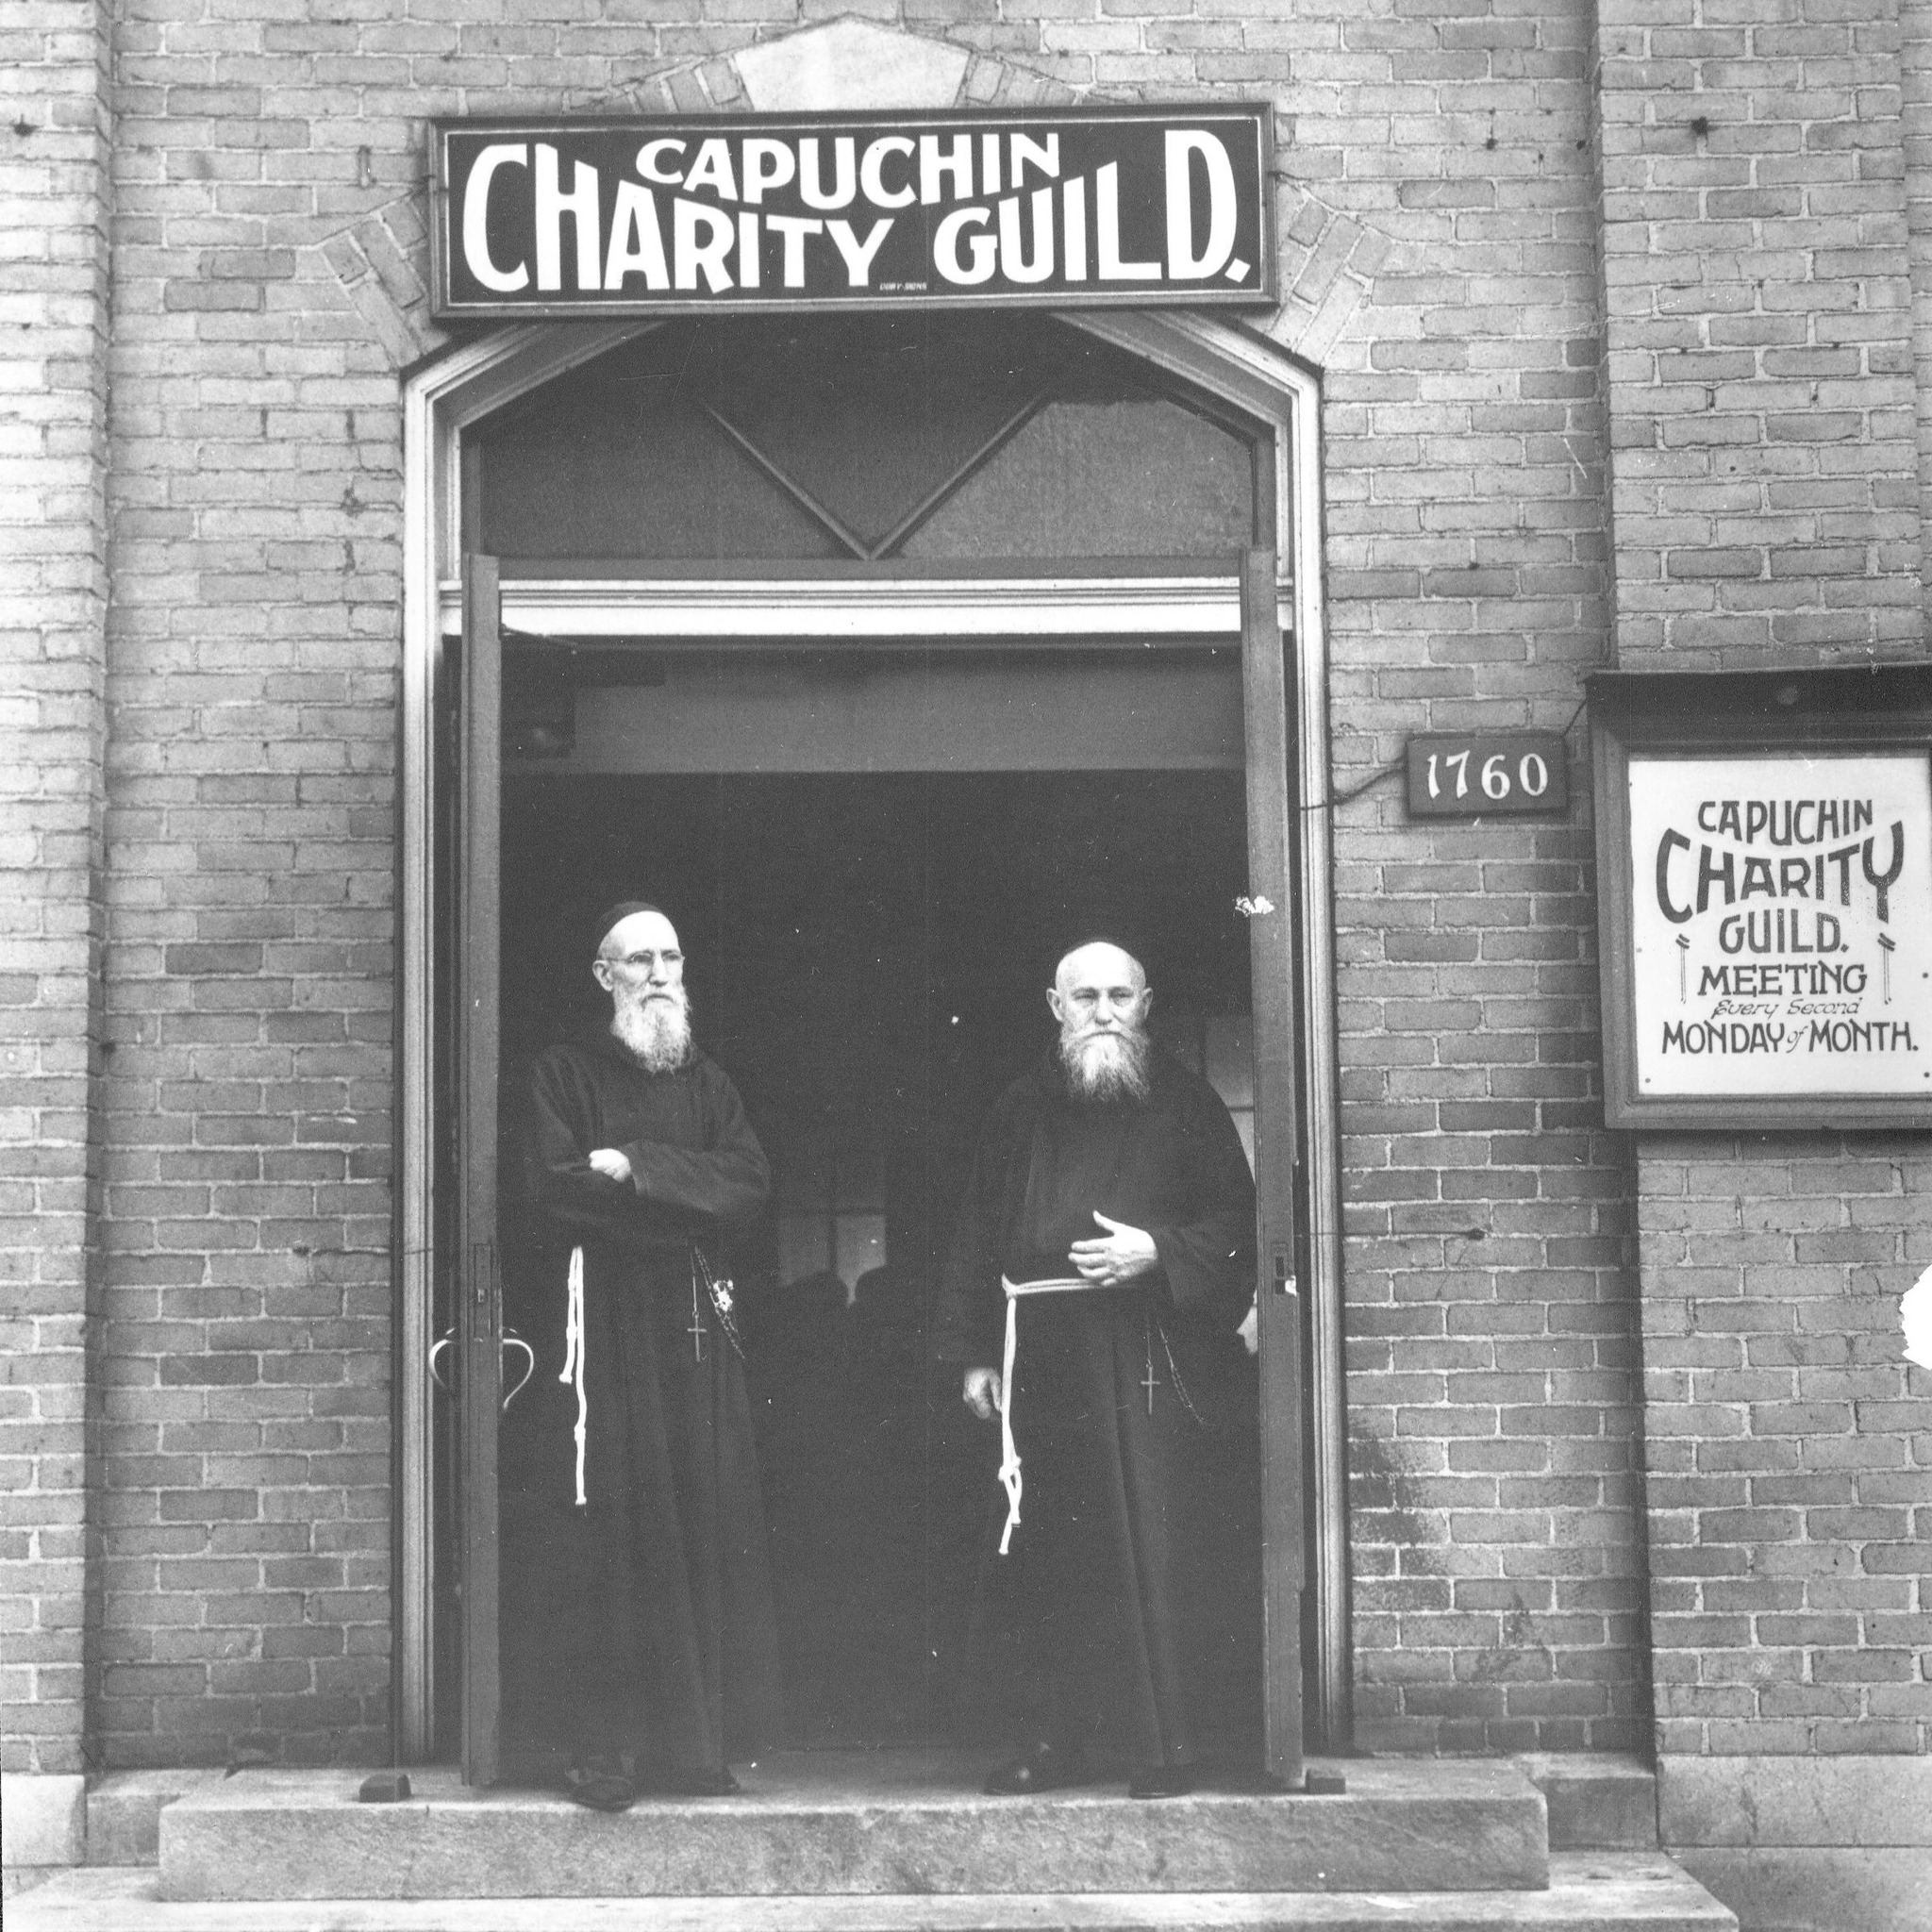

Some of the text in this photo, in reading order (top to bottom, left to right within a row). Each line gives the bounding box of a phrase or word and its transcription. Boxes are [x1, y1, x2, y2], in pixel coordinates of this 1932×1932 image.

[635, 132, 1060, 210] CAPUCHIN
[462, 129, 1252, 294] CHARITY GUILD.
[1426, 749, 1549, 800] 1760
[1697, 799, 1874, 846] CAPUCHIN
[1656, 820, 1905, 924] CHARITY
[1719, 908, 1850, 955] GUILD.
[1696, 959, 1868, 998] MEETING
[1710, 996, 1864, 1020] Every Second
[1661, 1018, 1920, 1055] MONDAY of MONTH.
